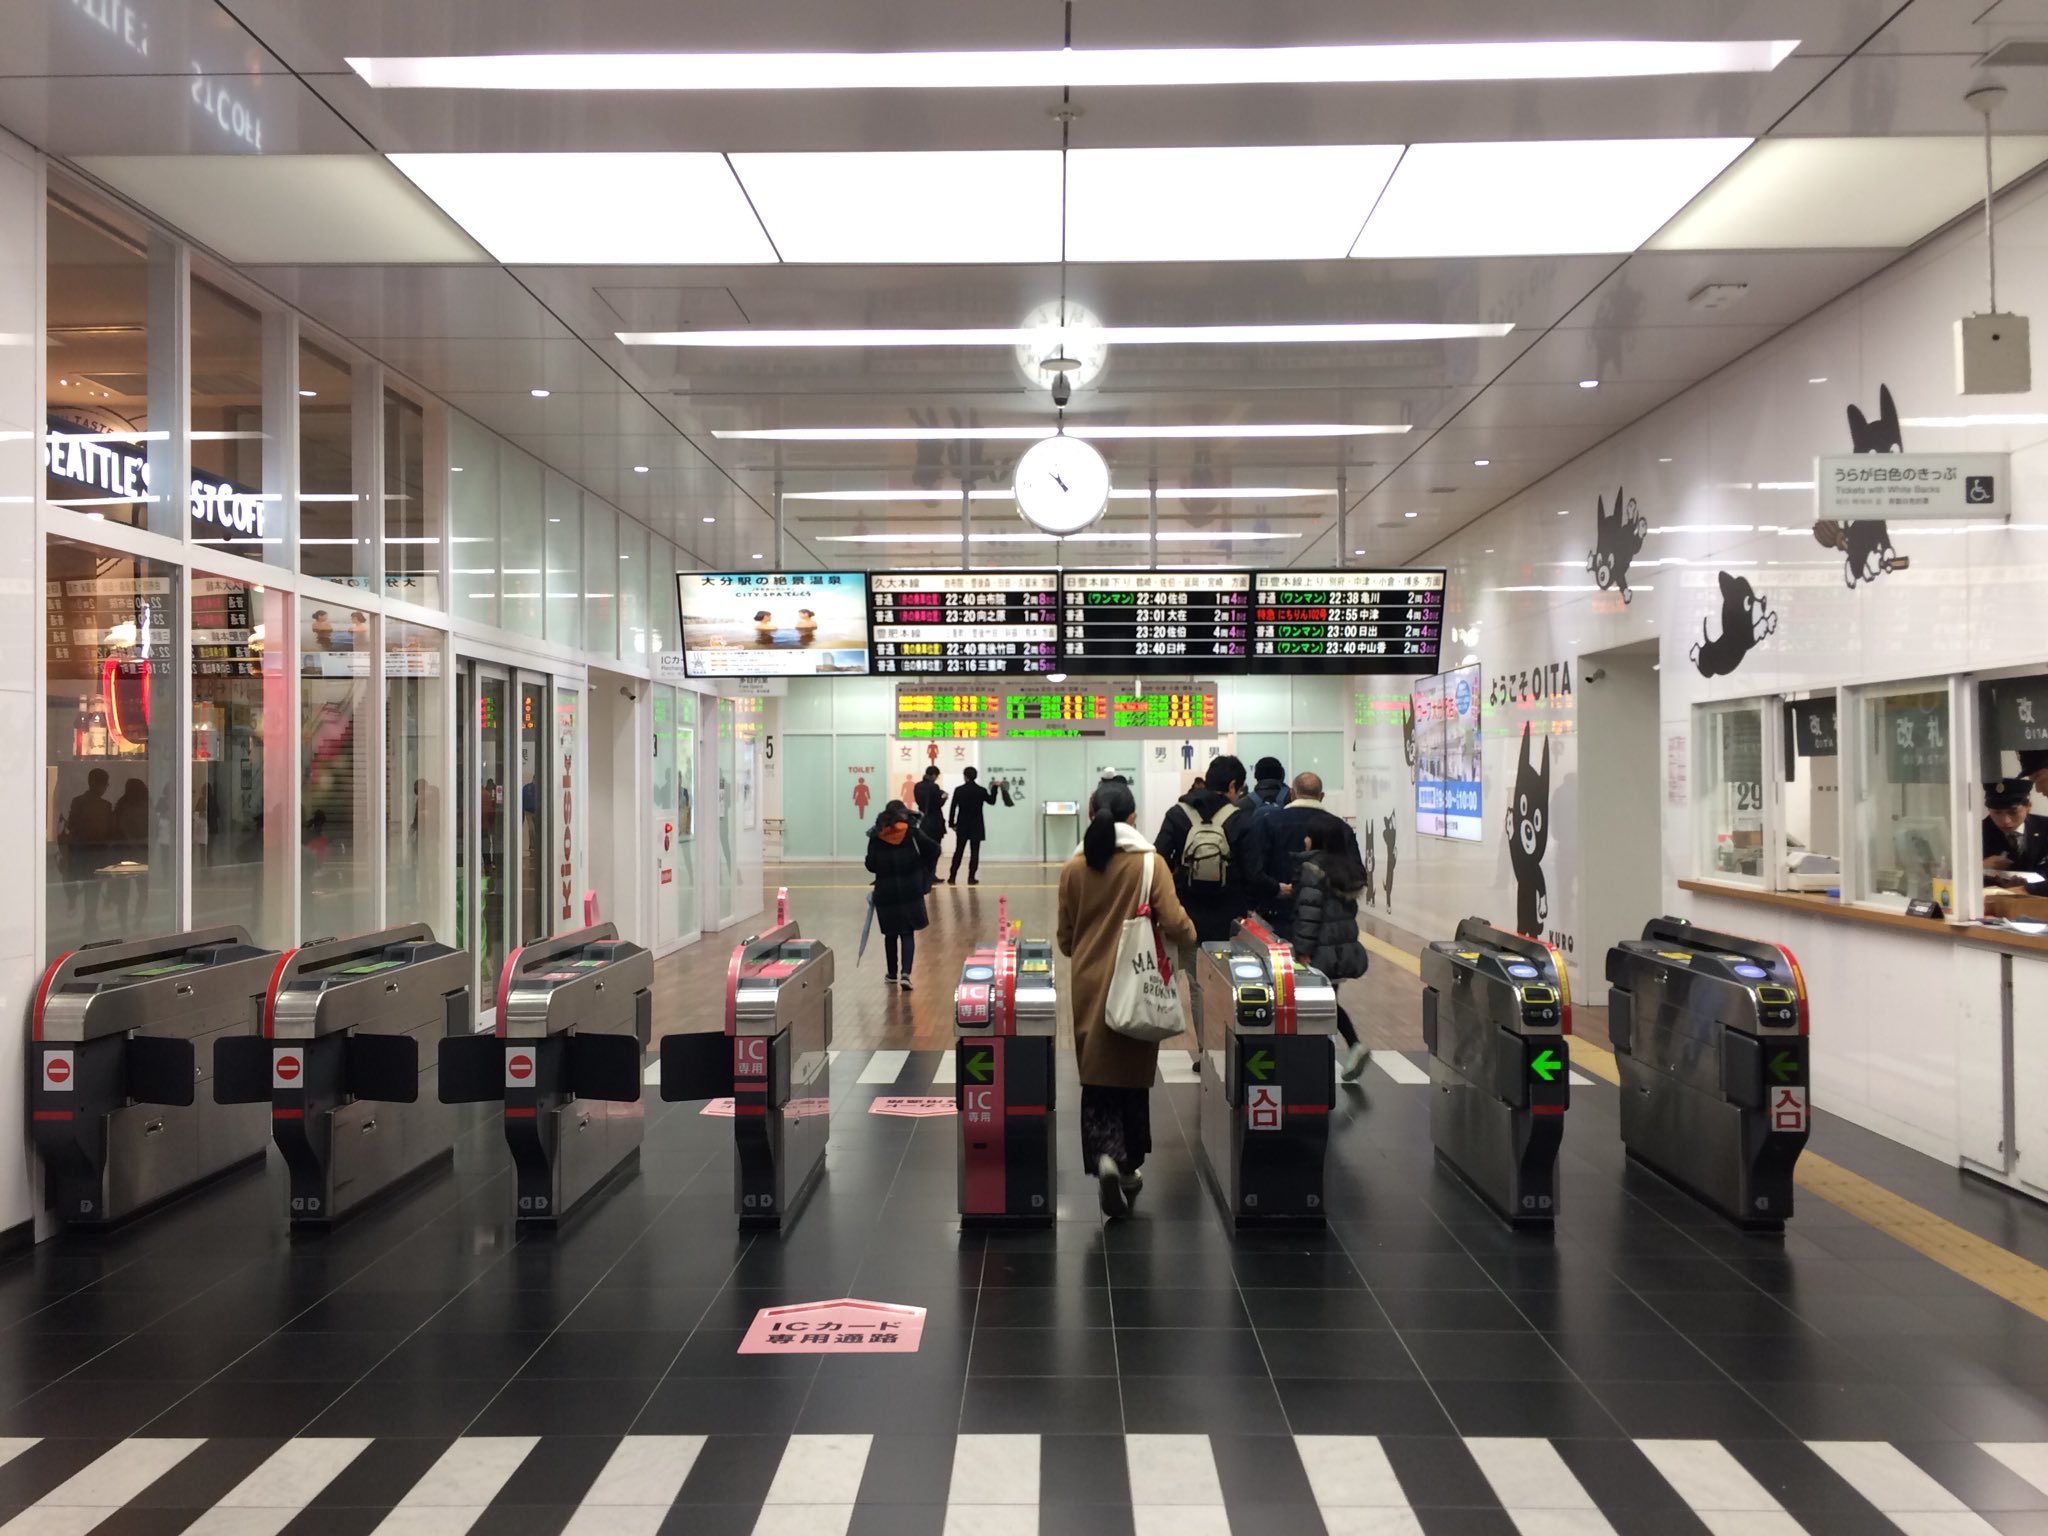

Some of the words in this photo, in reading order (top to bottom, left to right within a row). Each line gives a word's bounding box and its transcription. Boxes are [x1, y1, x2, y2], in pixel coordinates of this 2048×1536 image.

[1836, 468, 1957, 482] うらが白色のきっぷ
[217, 484, 264, 536] COFF
[702, 576, 842, 586] 大分駅の絶景温泉
[875, 578, 920, 588] 久大本線
[1067, 578, 1131, 587] 日豊本線下り
[1260, 578, 1324, 587] 日豊本線上り
[875, 594, 894, 606] 普通
[946, 594, 975, 606] 22:40
[977, 594, 1006, 606] 由布院
[1066, 593, 1084, 605] 普通
[1088, 593, 1134, 605] (ワンマン)
[1136, 593, 1167, 605] 22:40
[1168, 593, 1187, 605] 佐伯
[1258, 592, 1276, 604] 普通
[1280, 592, 1326, 604] (ワンマン)
[1329, 592, 1358, 604] 22:38
[1360, 592, 1380, 604] 亀川
[875, 610, 894, 623] 普通
[946, 610, 976, 623] 23:20
[977, 610, 1006, 623] 向之原
[1066, 610, 1084, 621] 普通
[1136, 610, 1165, 621] 23:01
[1167, 610, 1187, 621] 大在
[1328, 609, 1358, 620] 22:55
[1360, 609, 1379, 620] 中津
[877, 628, 920, 638] 豊肥本線
[1066, 626, 1084, 638] 普通
[1136, 626, 1165, 638] 23:20
[1167, 626, 1186, 638] 佐伯
[1256, 625, 1275, 637] 普通
[1278, 625, 1324, 637] (ワンマン)
[1327, 625, 1357, 637] 23:00
[1359, 625, 1378, 637] 日出
[877, 644, 895, 655] 普通
[946, 644, 976, 655] 22:40
[977, 644, 1015, 655] 豊後竹田
[1066, 642, 1084, 655] 普通
[1136, 642, 1165, 655] 23:40
[1167, 642, 1186, 655] 臼杵
[1256, 642, 1274, 654] 普通
[1277, 642, 1323, 654] (ワンマン)
[1326, 642, 1355, 654] 23:40
[1357, 642, 1386, 654] 中山香
[877, 660, 896, 672] 普通
[947, 660, 976, 672] 23:16
[978, 660, 1006, 672] 三重町
[1490, 672, 1528, 706] ようこそ
[1532, 661, 1571, 700] OITA
[2016, 696, 2035, 724] 改
[1896, 716, 1944, 748] 改札
[766, 736, 774, 759] 5
[900, 746, 912, 756] 女
[954, 746, 965, 756] 女
[1156, 747, 1166, 759] 男
[1737, 782, 1762, 810] 29
[1549, 930, 1574, 953] KURO
[961, 986, 986, 1000] IC
[960, 1004, 986, 1016] 専用
[738, 1040, 764, 1060] IC
[739, 1062, 762, 1074] 専用
[968, 1091, 992, 1110] IC
[1252, 1088, 1278, 1127] 入口
[1776, 1090, 1801, 1128] 入口
[968, 1112, 991, 1123] 専用
[772, 1321, 902, 1332] ICカード
[766, 1333, 898, 1344] 専用通路
